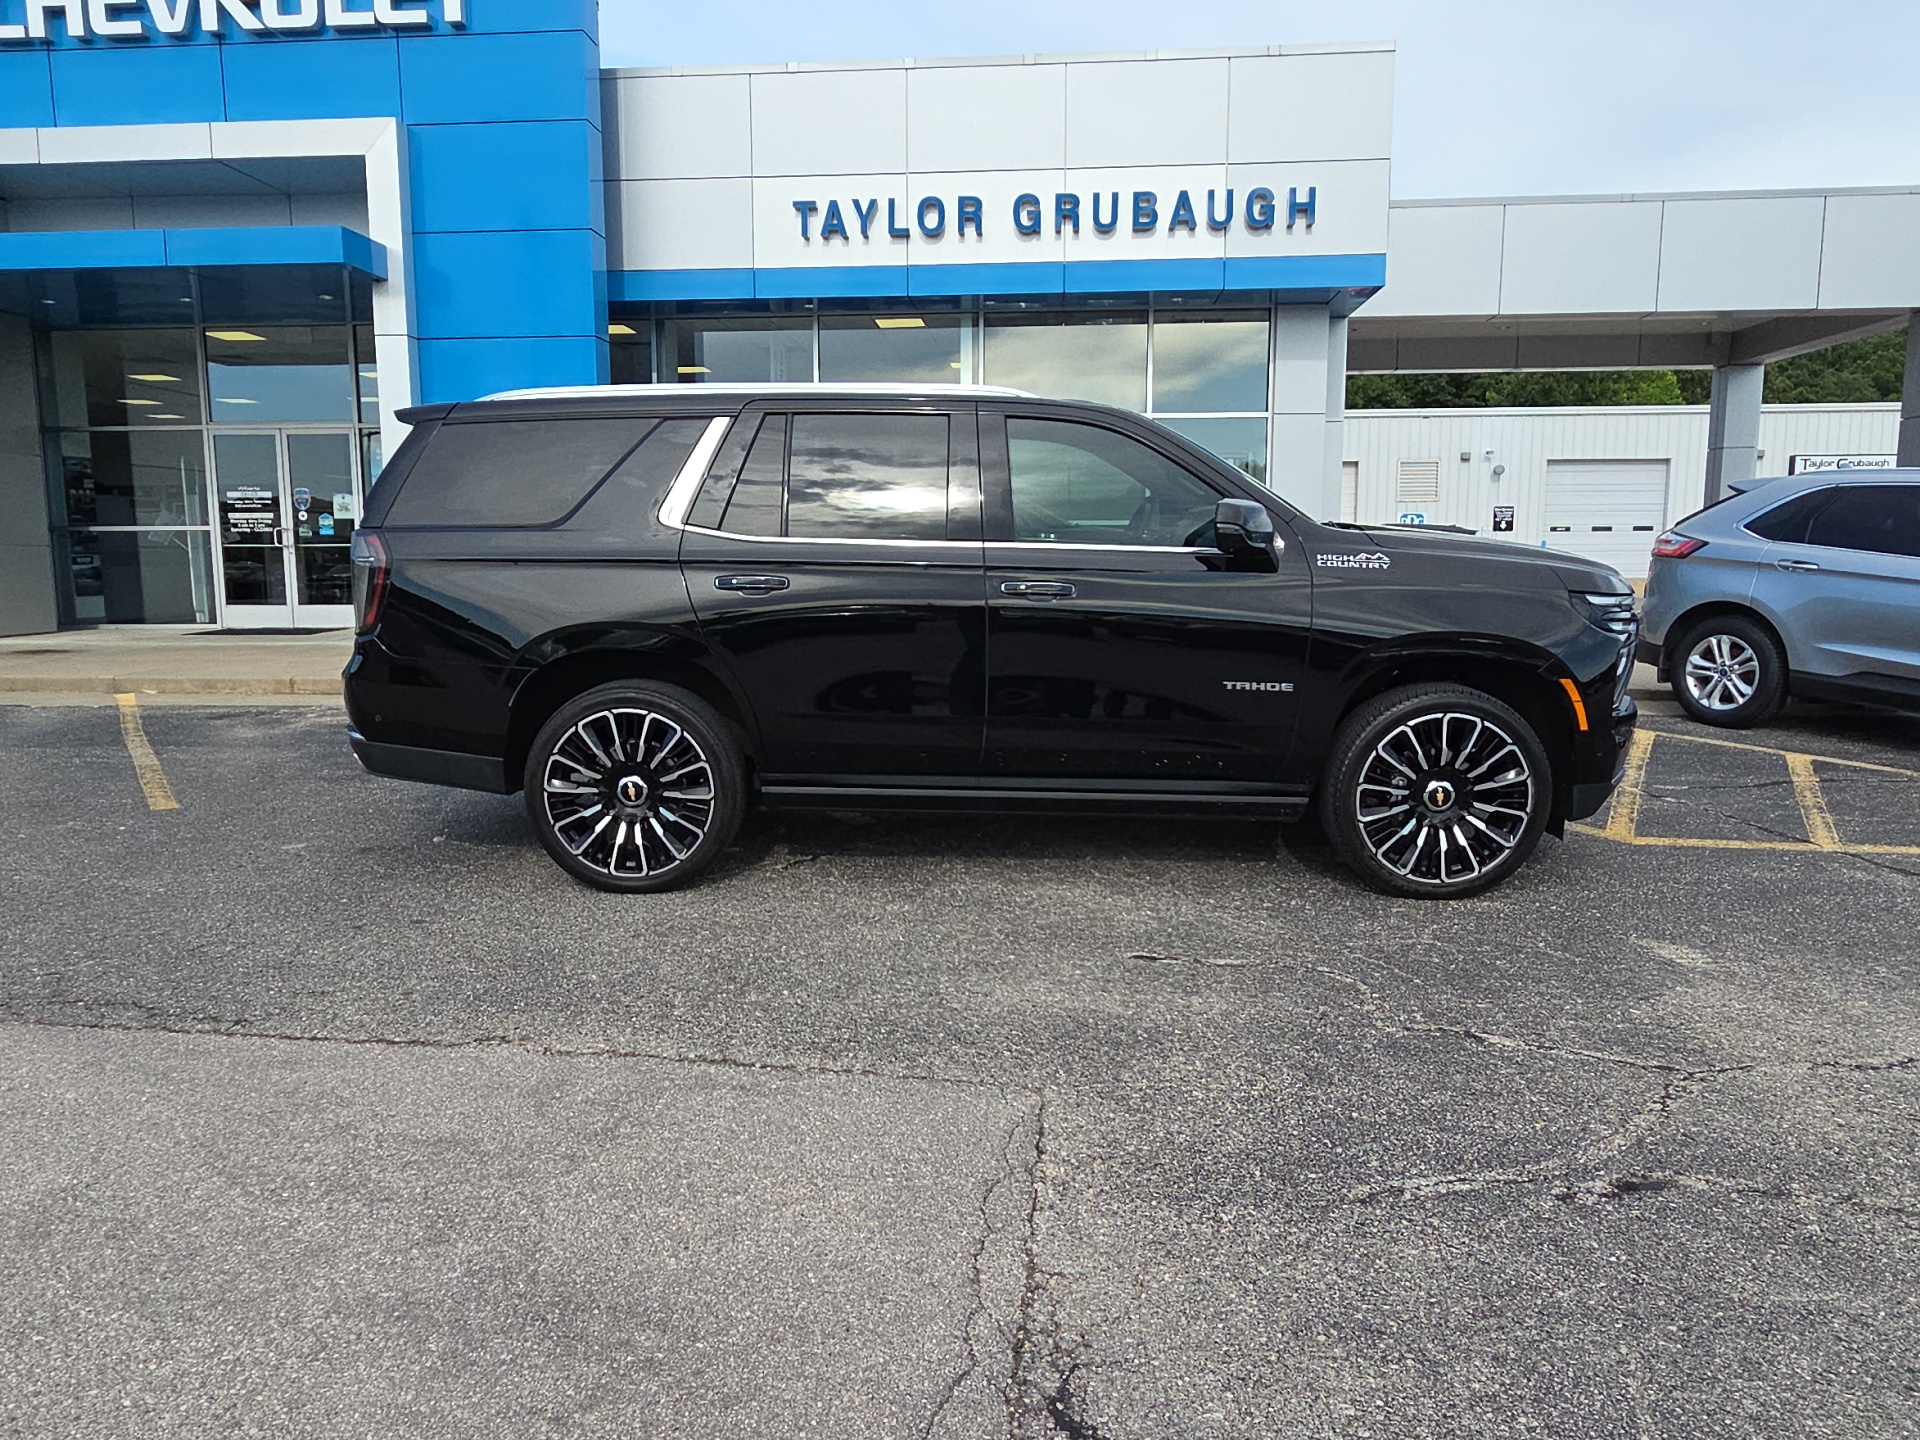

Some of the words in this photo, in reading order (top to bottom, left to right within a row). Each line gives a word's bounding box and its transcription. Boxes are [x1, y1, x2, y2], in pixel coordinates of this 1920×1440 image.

[792, 195, 984, 241] TAYLOR
[1013, 187, 1316, 234] GRUBAUGH
[1800, 458, 1835, 470] Taylor
[1316, 560, 1390, 569] COUNTRY
[1222, 681, 1294, 692] TAHOE
